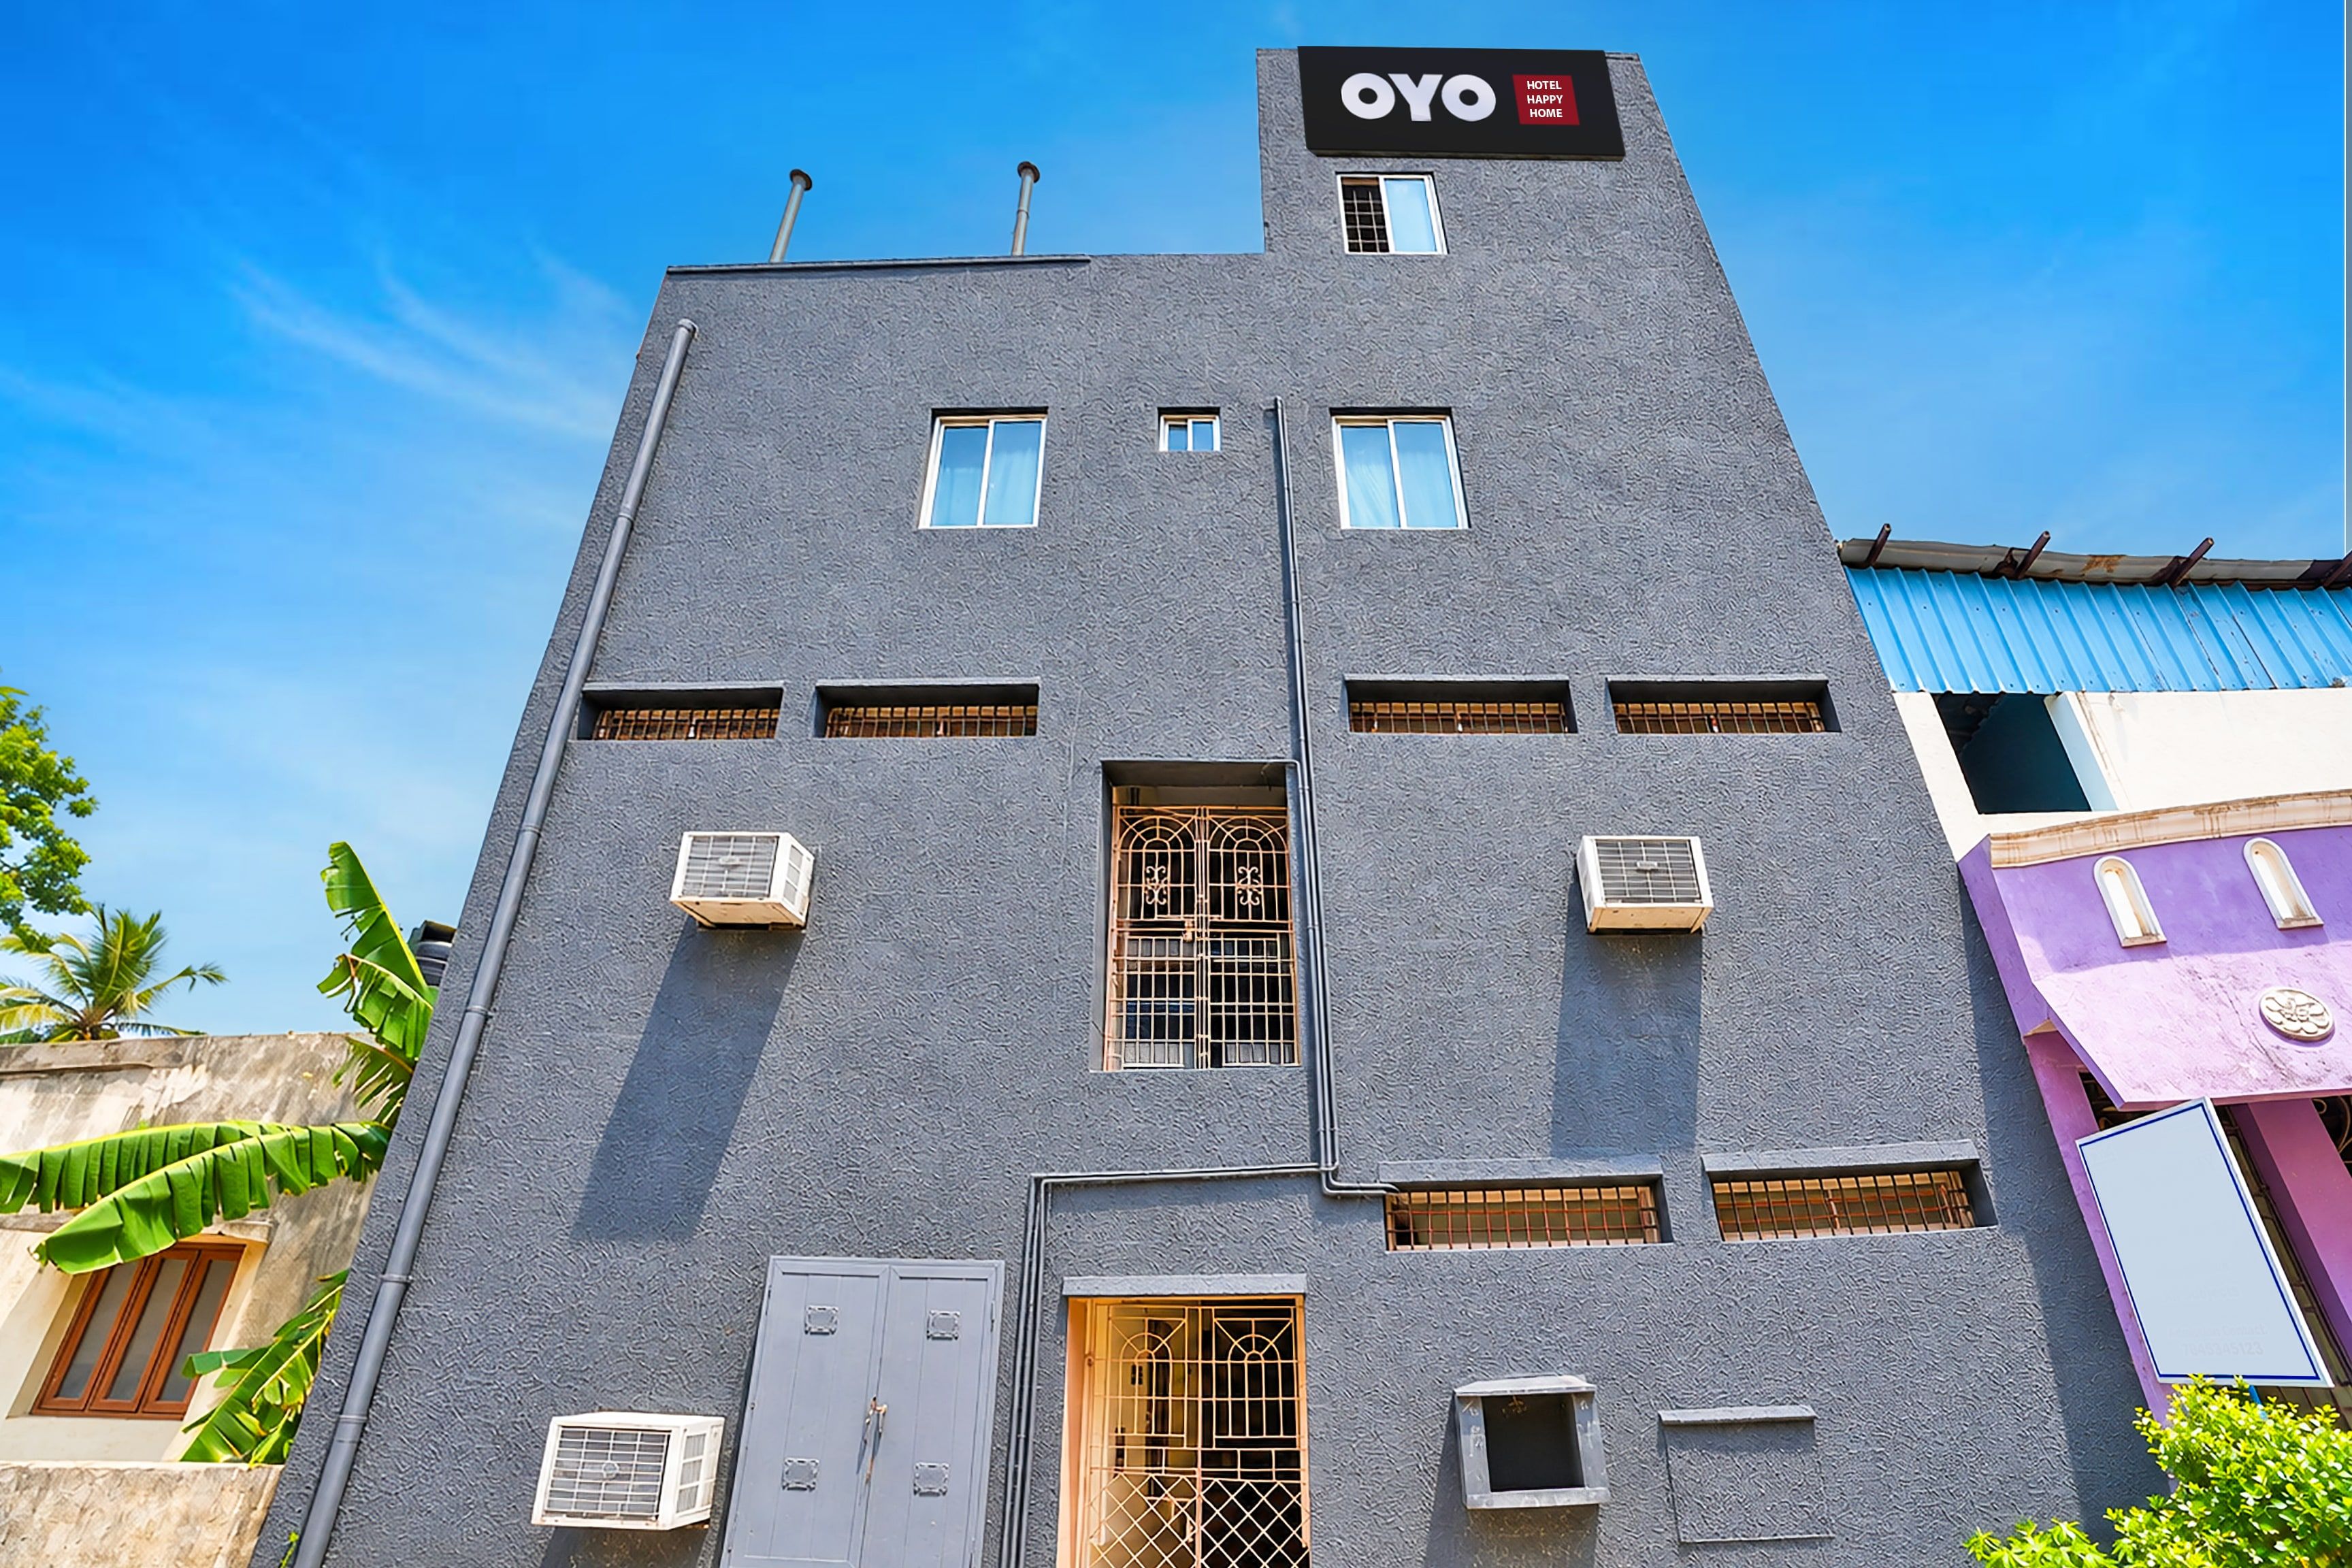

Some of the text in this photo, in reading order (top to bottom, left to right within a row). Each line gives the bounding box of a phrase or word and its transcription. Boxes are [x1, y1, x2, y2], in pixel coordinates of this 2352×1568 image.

[1526, 80, 1563, 90] HOTEL
[1341, 72, 1497, 122] OYO
[1526, 95, 1563, 104] HAPPY
[1529, 108, 1563, 118] HOME
